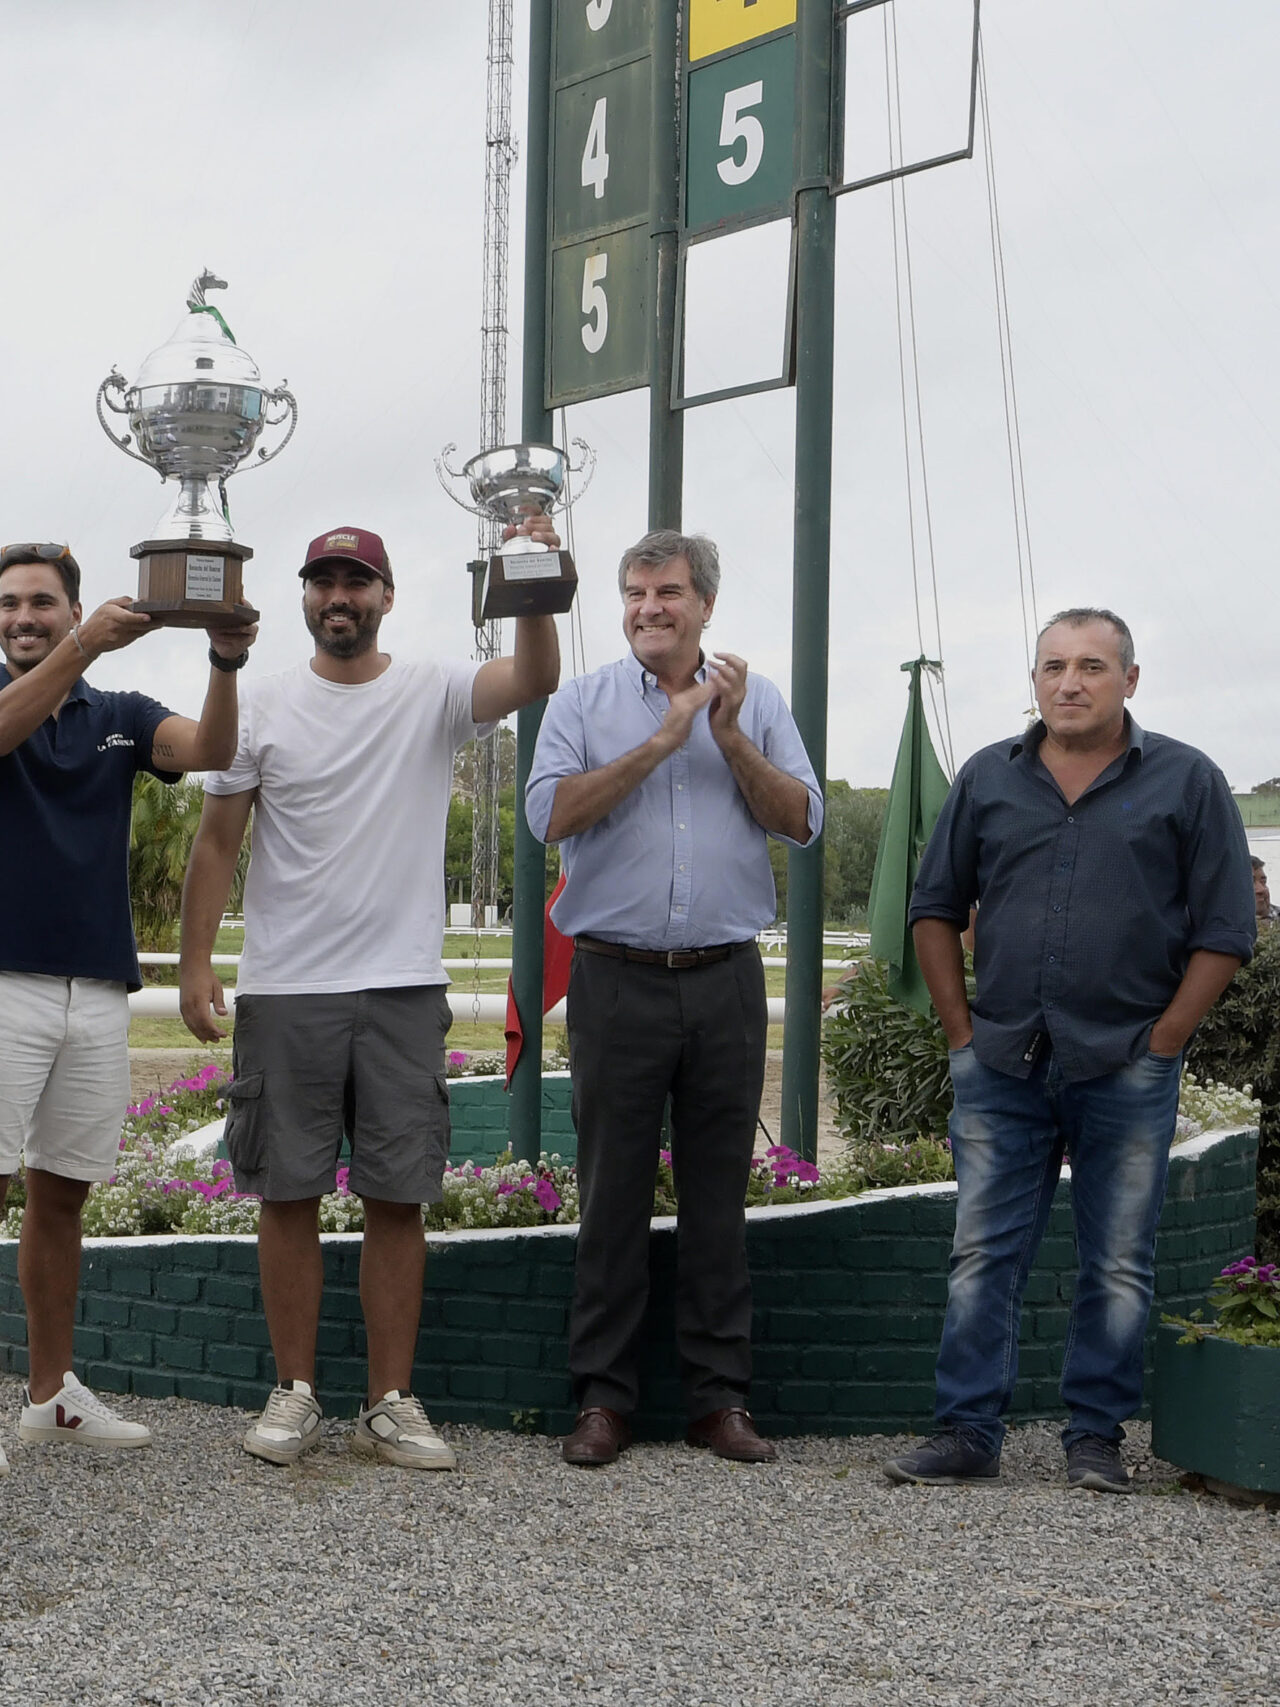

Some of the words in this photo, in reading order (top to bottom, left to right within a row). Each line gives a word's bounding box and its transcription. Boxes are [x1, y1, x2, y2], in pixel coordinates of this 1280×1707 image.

[580, 96, 610, 199] 4
[716, 79, 765, 186] 5
[580, 252, 608, 354] 5
